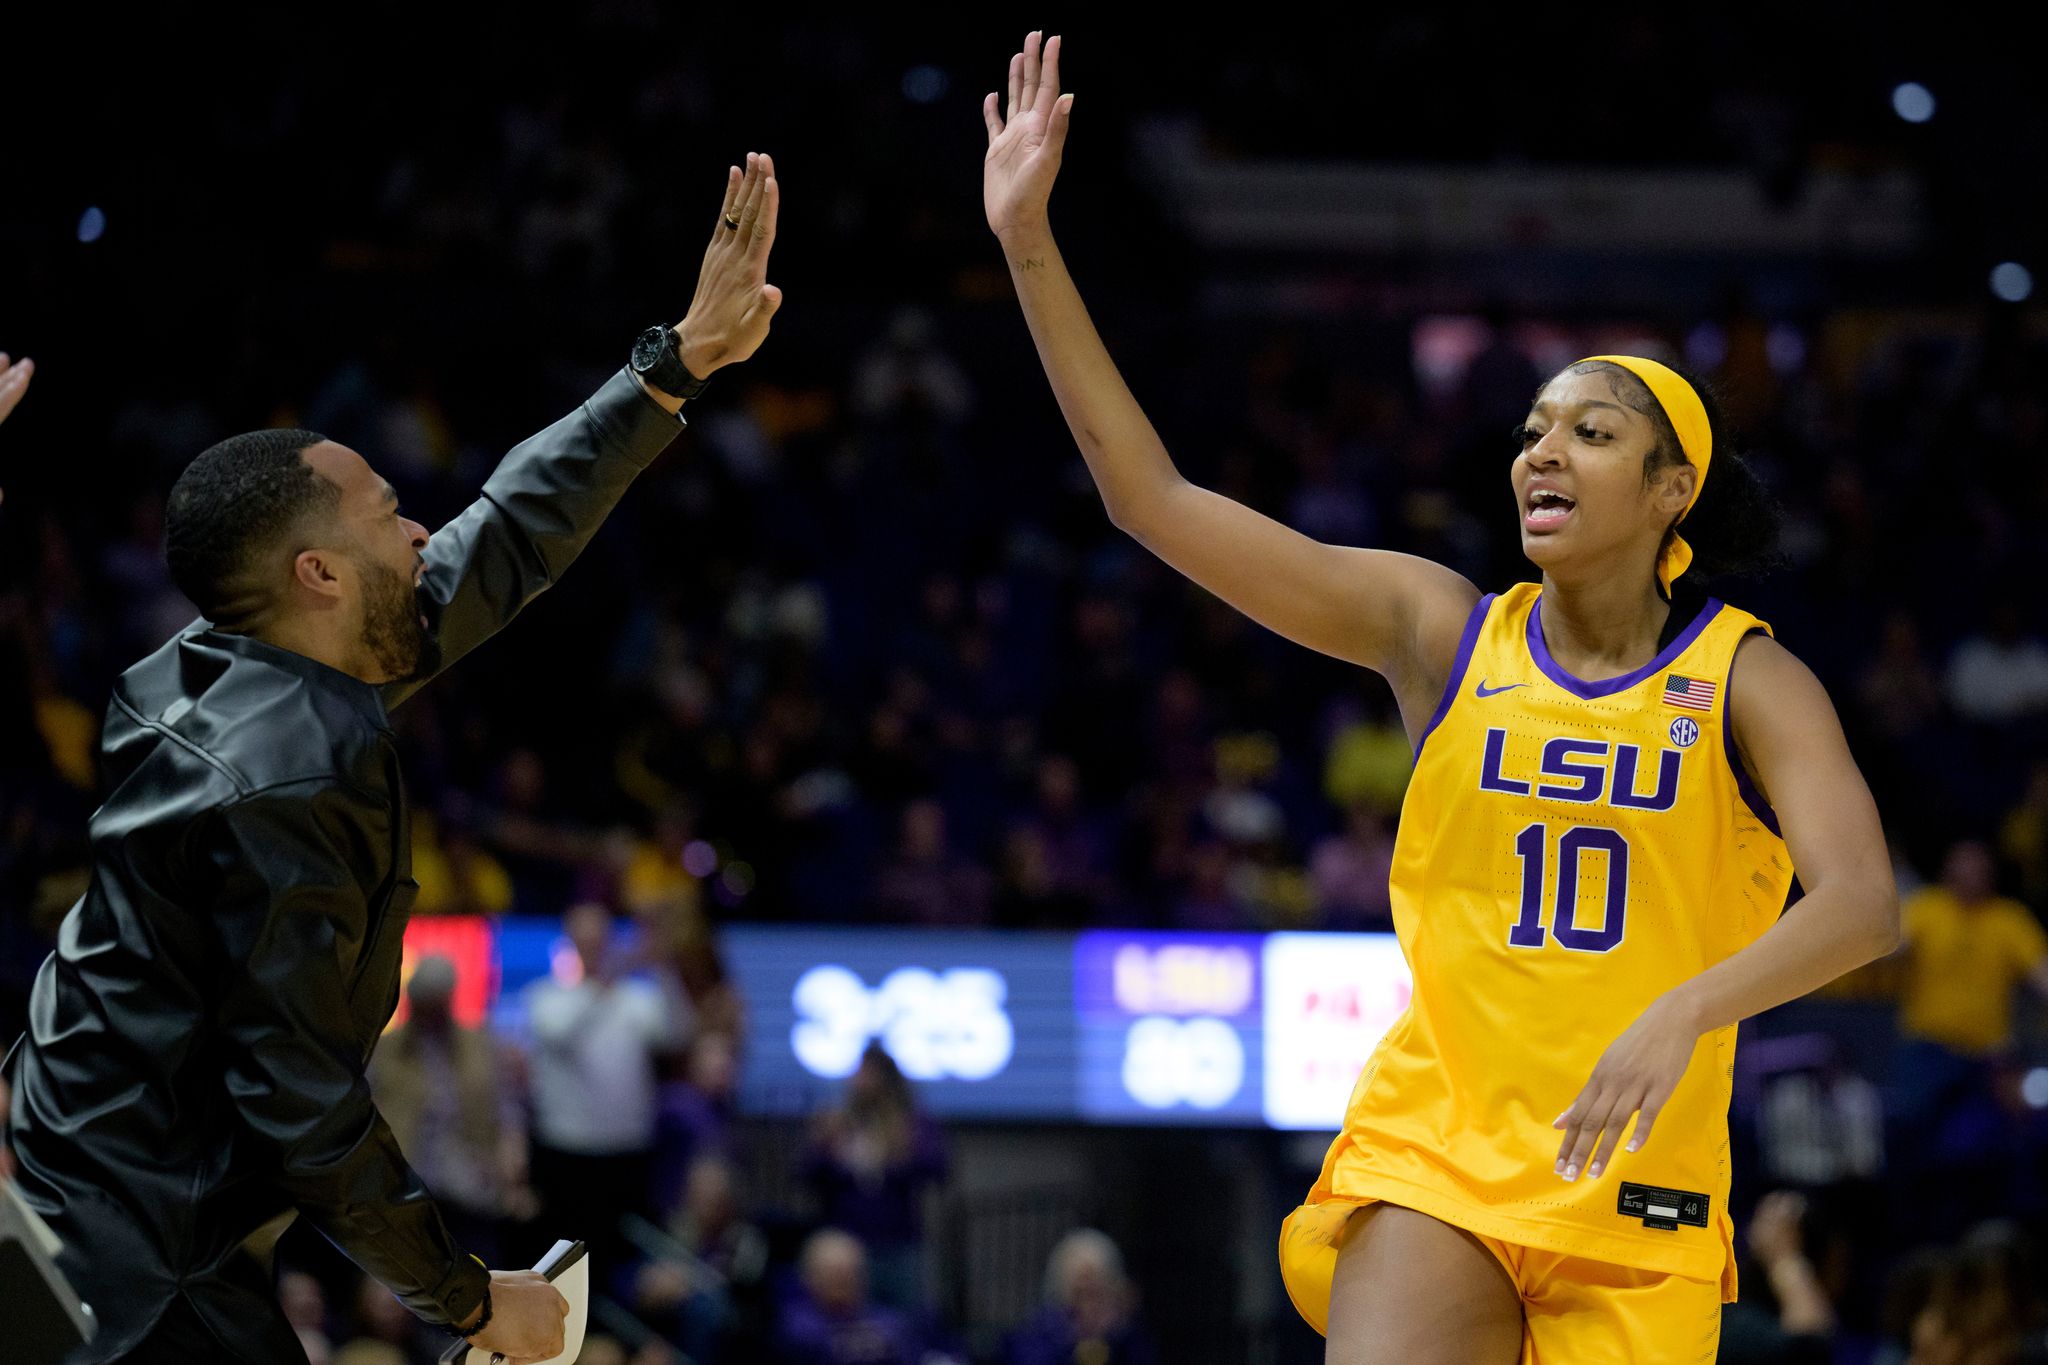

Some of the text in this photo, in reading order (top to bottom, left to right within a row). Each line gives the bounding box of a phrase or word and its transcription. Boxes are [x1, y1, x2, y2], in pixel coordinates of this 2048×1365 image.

[1671, 718, 1698, 746] SEC
[1478, 727, 1683, 812] LSU
[1508, 823, 1629, 952] 10
[1684, 1201, 1698, 1215] 48
